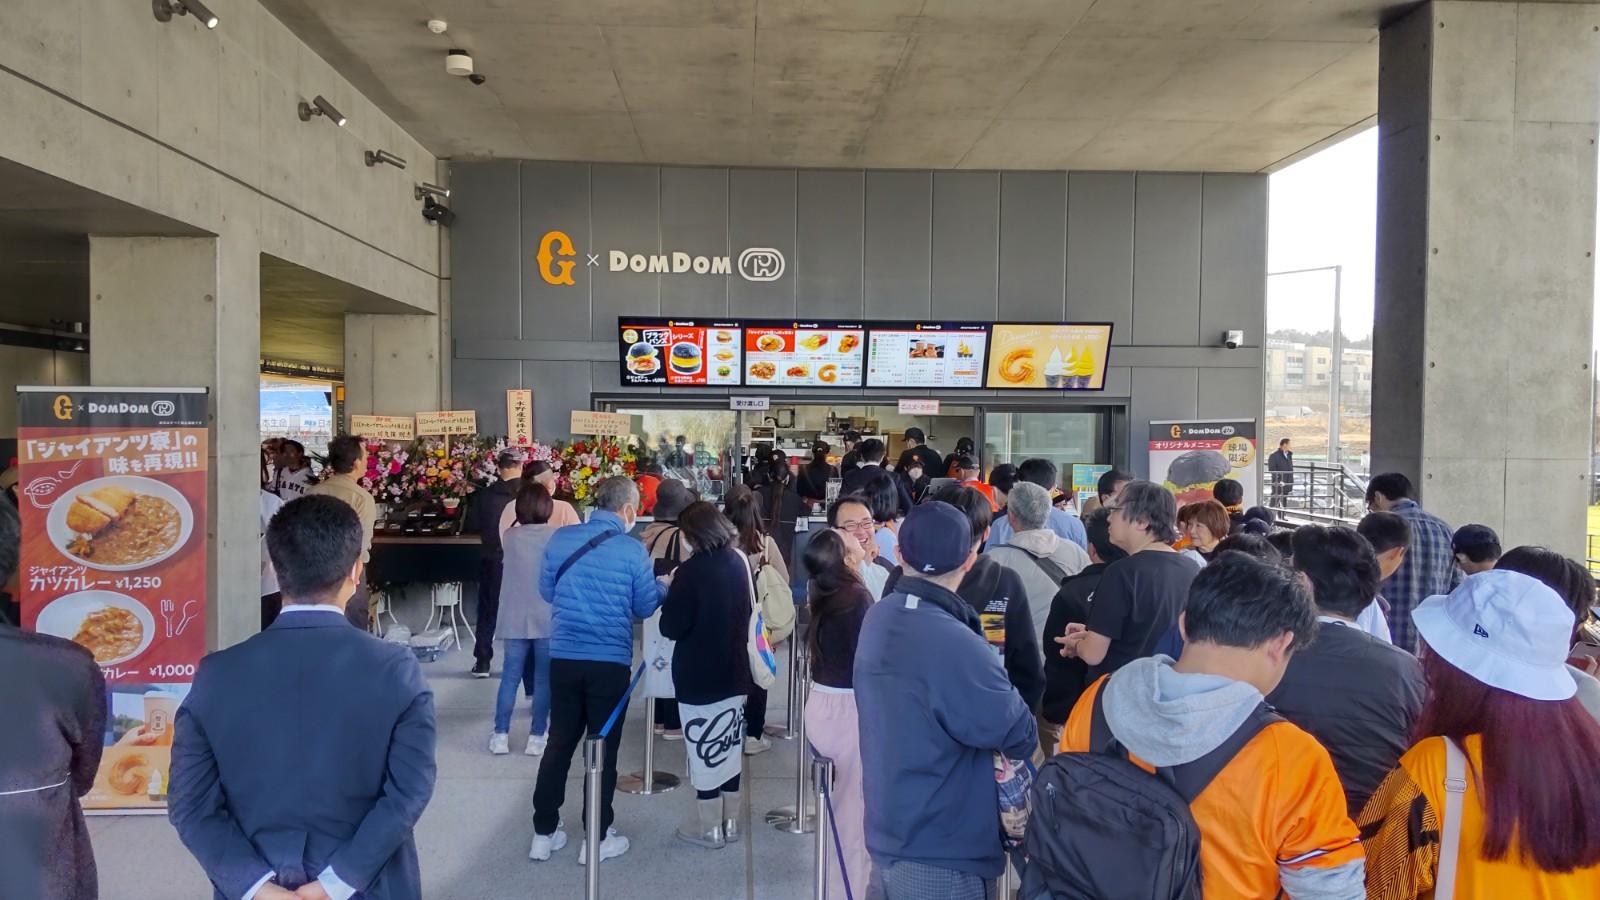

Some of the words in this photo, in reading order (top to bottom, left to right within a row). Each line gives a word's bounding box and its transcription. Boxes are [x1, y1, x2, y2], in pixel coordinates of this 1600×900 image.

[537, 231, 576, 286] G
[53, 395, 72, 420] G
[27, 431, 197, 460] 「ジャイアンツ寮」の
[1154, 441, 1220, 449] オリジナルメニュー
[1228, 443, 1248, 452] 球場
[1228, 453, 1248, 463] 限定
[30, 566, 87, 576] ジャイアンツ
[30, 575, 111, 592] カツカレー
[115, 576, 162, 592] ¥1,250
[101, 667, 140, 680] カレー
[149, 664, 195, 678] ¥1,000
